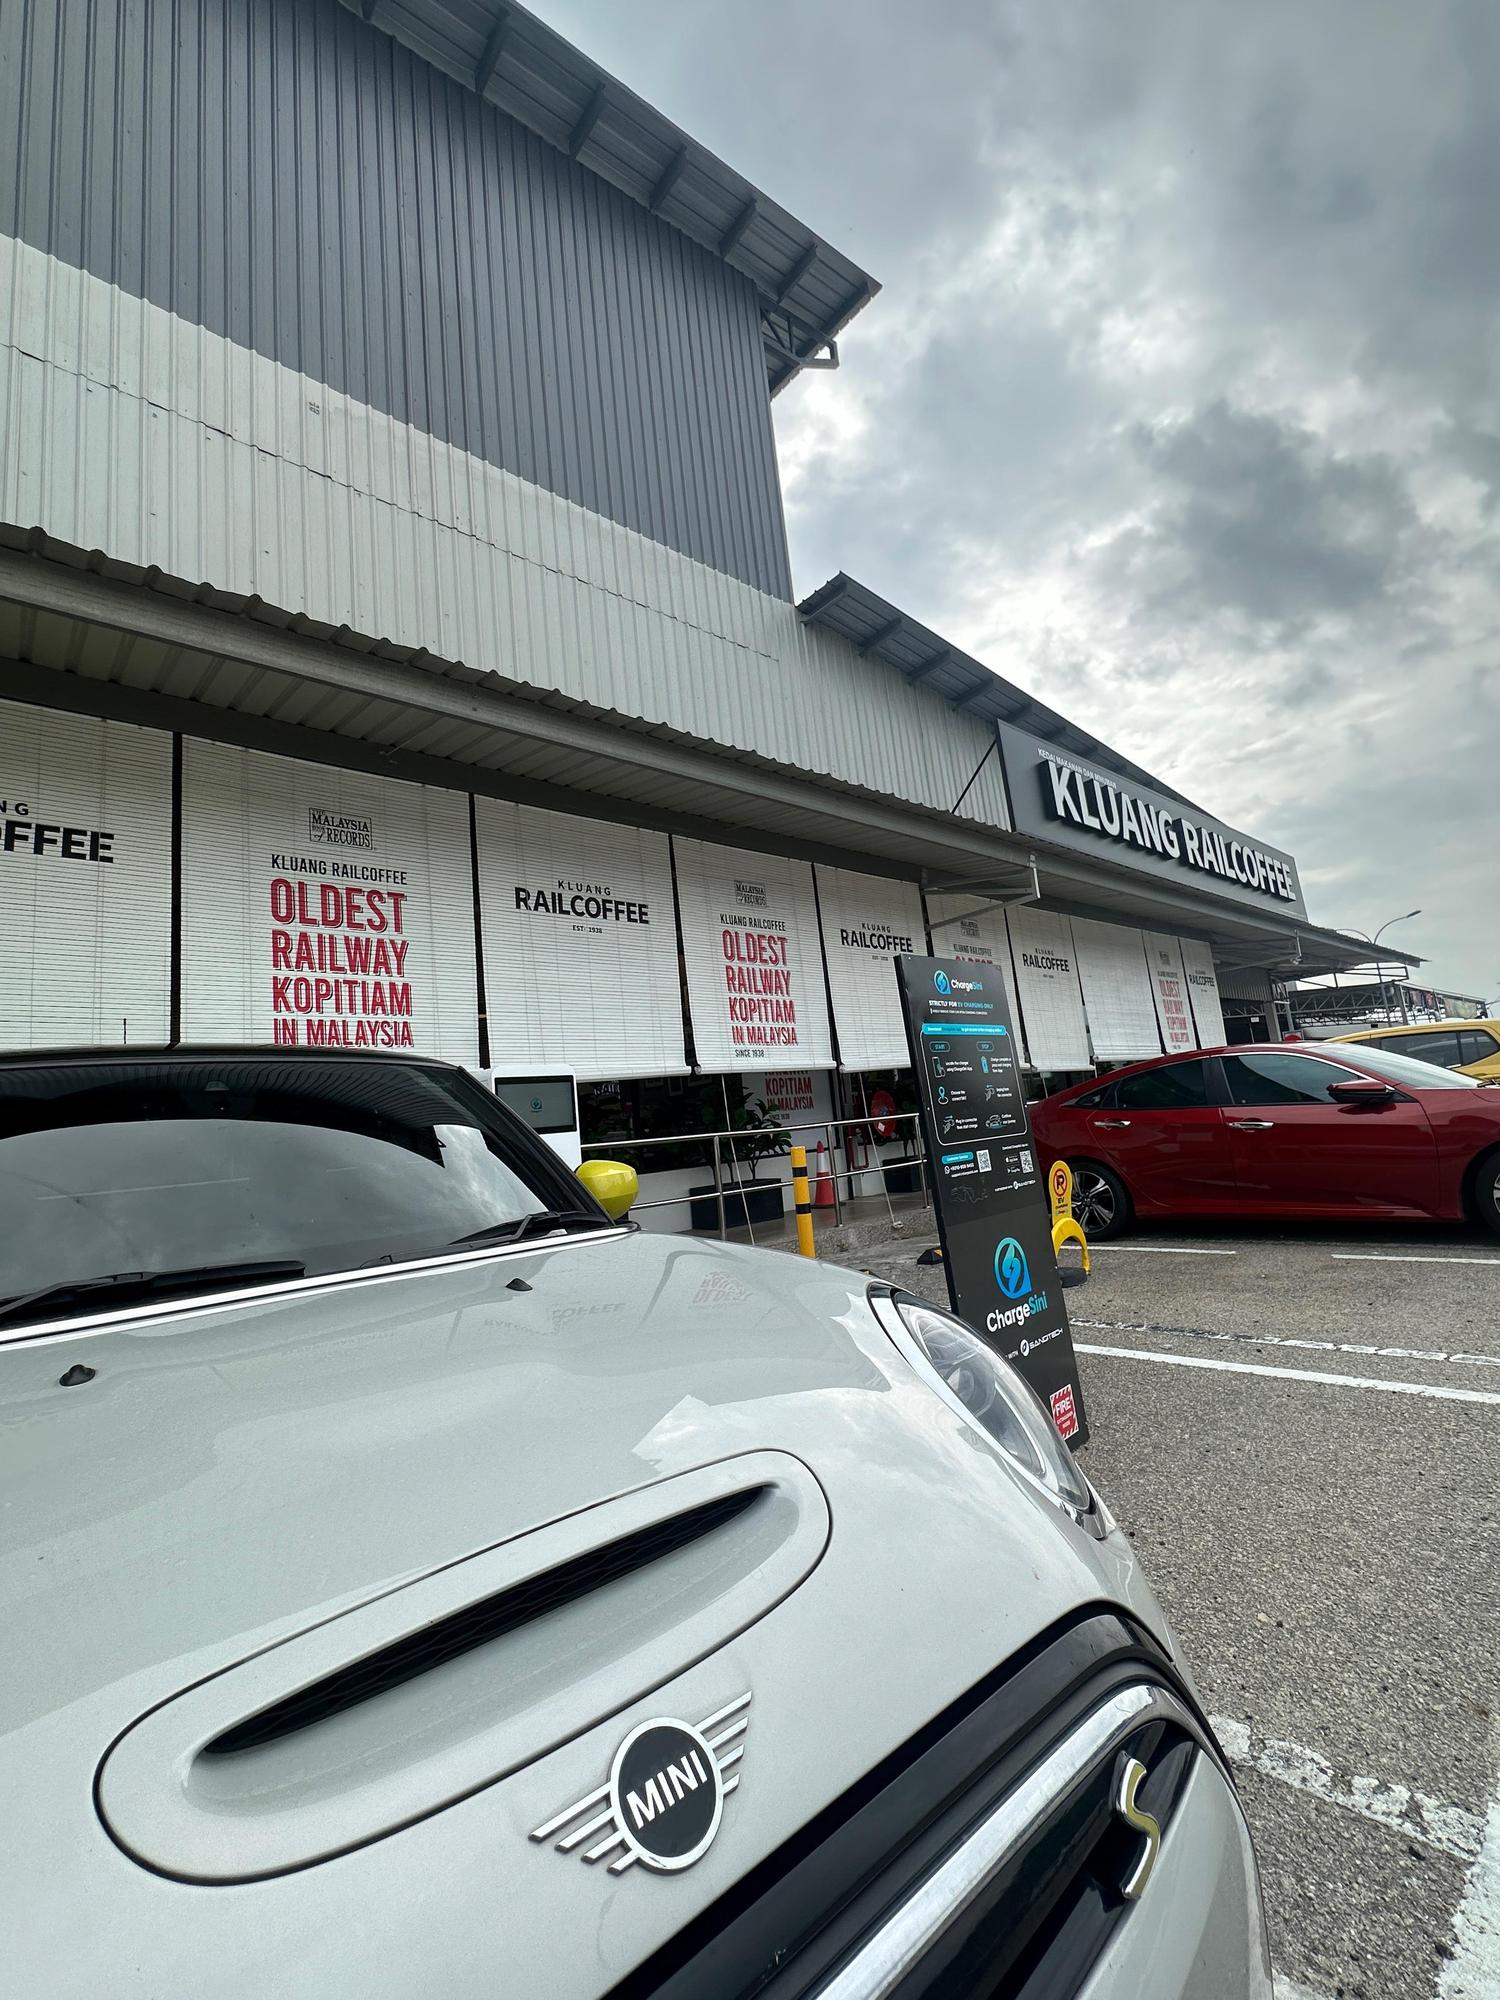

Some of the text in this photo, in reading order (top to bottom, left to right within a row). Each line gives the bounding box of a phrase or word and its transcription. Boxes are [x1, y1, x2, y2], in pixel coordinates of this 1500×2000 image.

[311, 813, 370, 832] MALAYSIA
[1047, 760, 1297, 901] KLUANG RAILCOFFEE
[326, 827, 371, 848] RECORDS
[271, 853, 408, 886] KLUANG RAILCOFFEE
[557, 879, 611, 896] KLUANG
[270, 877, 408, 935] OLDEST
[514, 886, 650, 925] RAILCOFFEE
[720, 913, 786, 932] KLUANG RAILCOFFEE
[861, 922, 891, 933] KLUANG
[271, 929, 410, 978] RAILWAY
[721, 929, 788, 967] OLDEST
[840, 928, 914, 953] RAILCOFFEE
[1022, 953, 1070, 972] RAILCOFFEE
[725, 964, 792, 997] RAILWAY
[272, 975, 413, 1017] KOPITIAM
[728, 996, 797, 1025] KOPITIAM
[273, 1017, 414, 1048] IN MALAYSIA
[731, 1025, 799, 1047] IN MALAYSIA
[735, 1049, 765, 1059] SINCE 1938
[765, 1076, 812, 1096] KOPITIAM
[777, 1096, 815, 1111] MALAYSIA
[986, 1290, 1048, 1333] ChargeSini
[1054, 1396, 1072, 1417] FIRE
[625, 1748, 708, 1831] MINI
